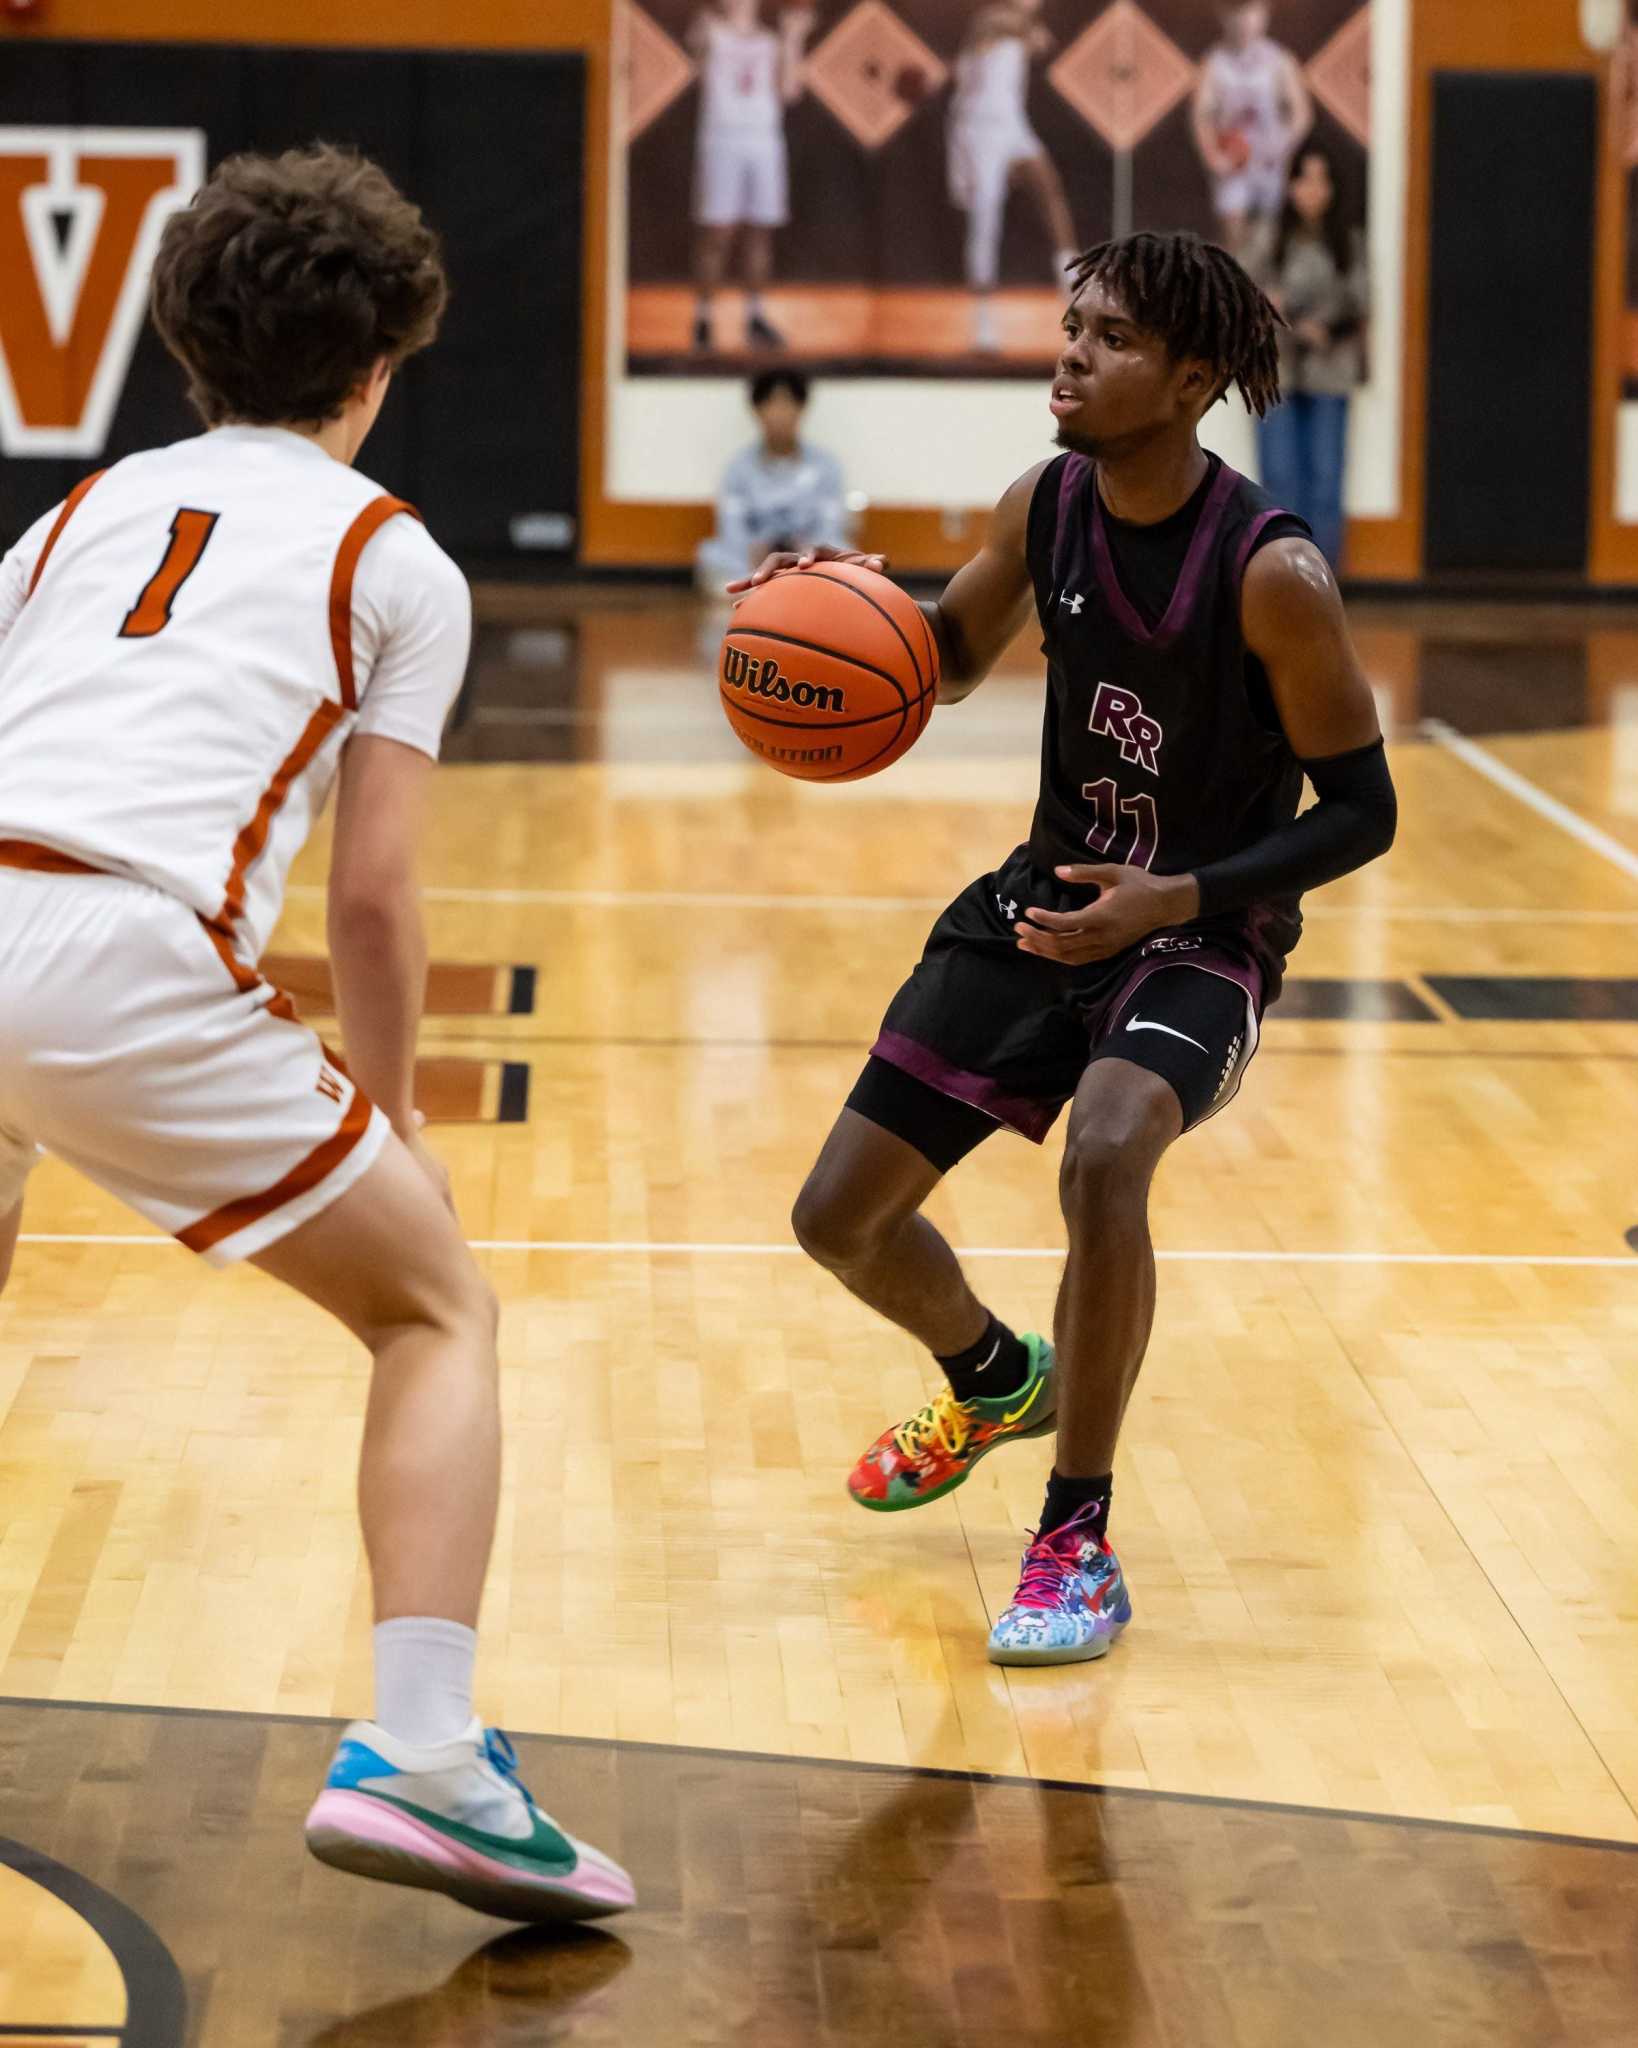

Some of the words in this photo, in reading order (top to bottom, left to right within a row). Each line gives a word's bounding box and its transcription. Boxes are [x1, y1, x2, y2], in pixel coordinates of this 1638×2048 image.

[117, 507, 221, 638] 1
[724, 643, 845, 713] Wilson
[1088, 681, 1162, 776] RR
[1081, 777, 1159, 871] 11
